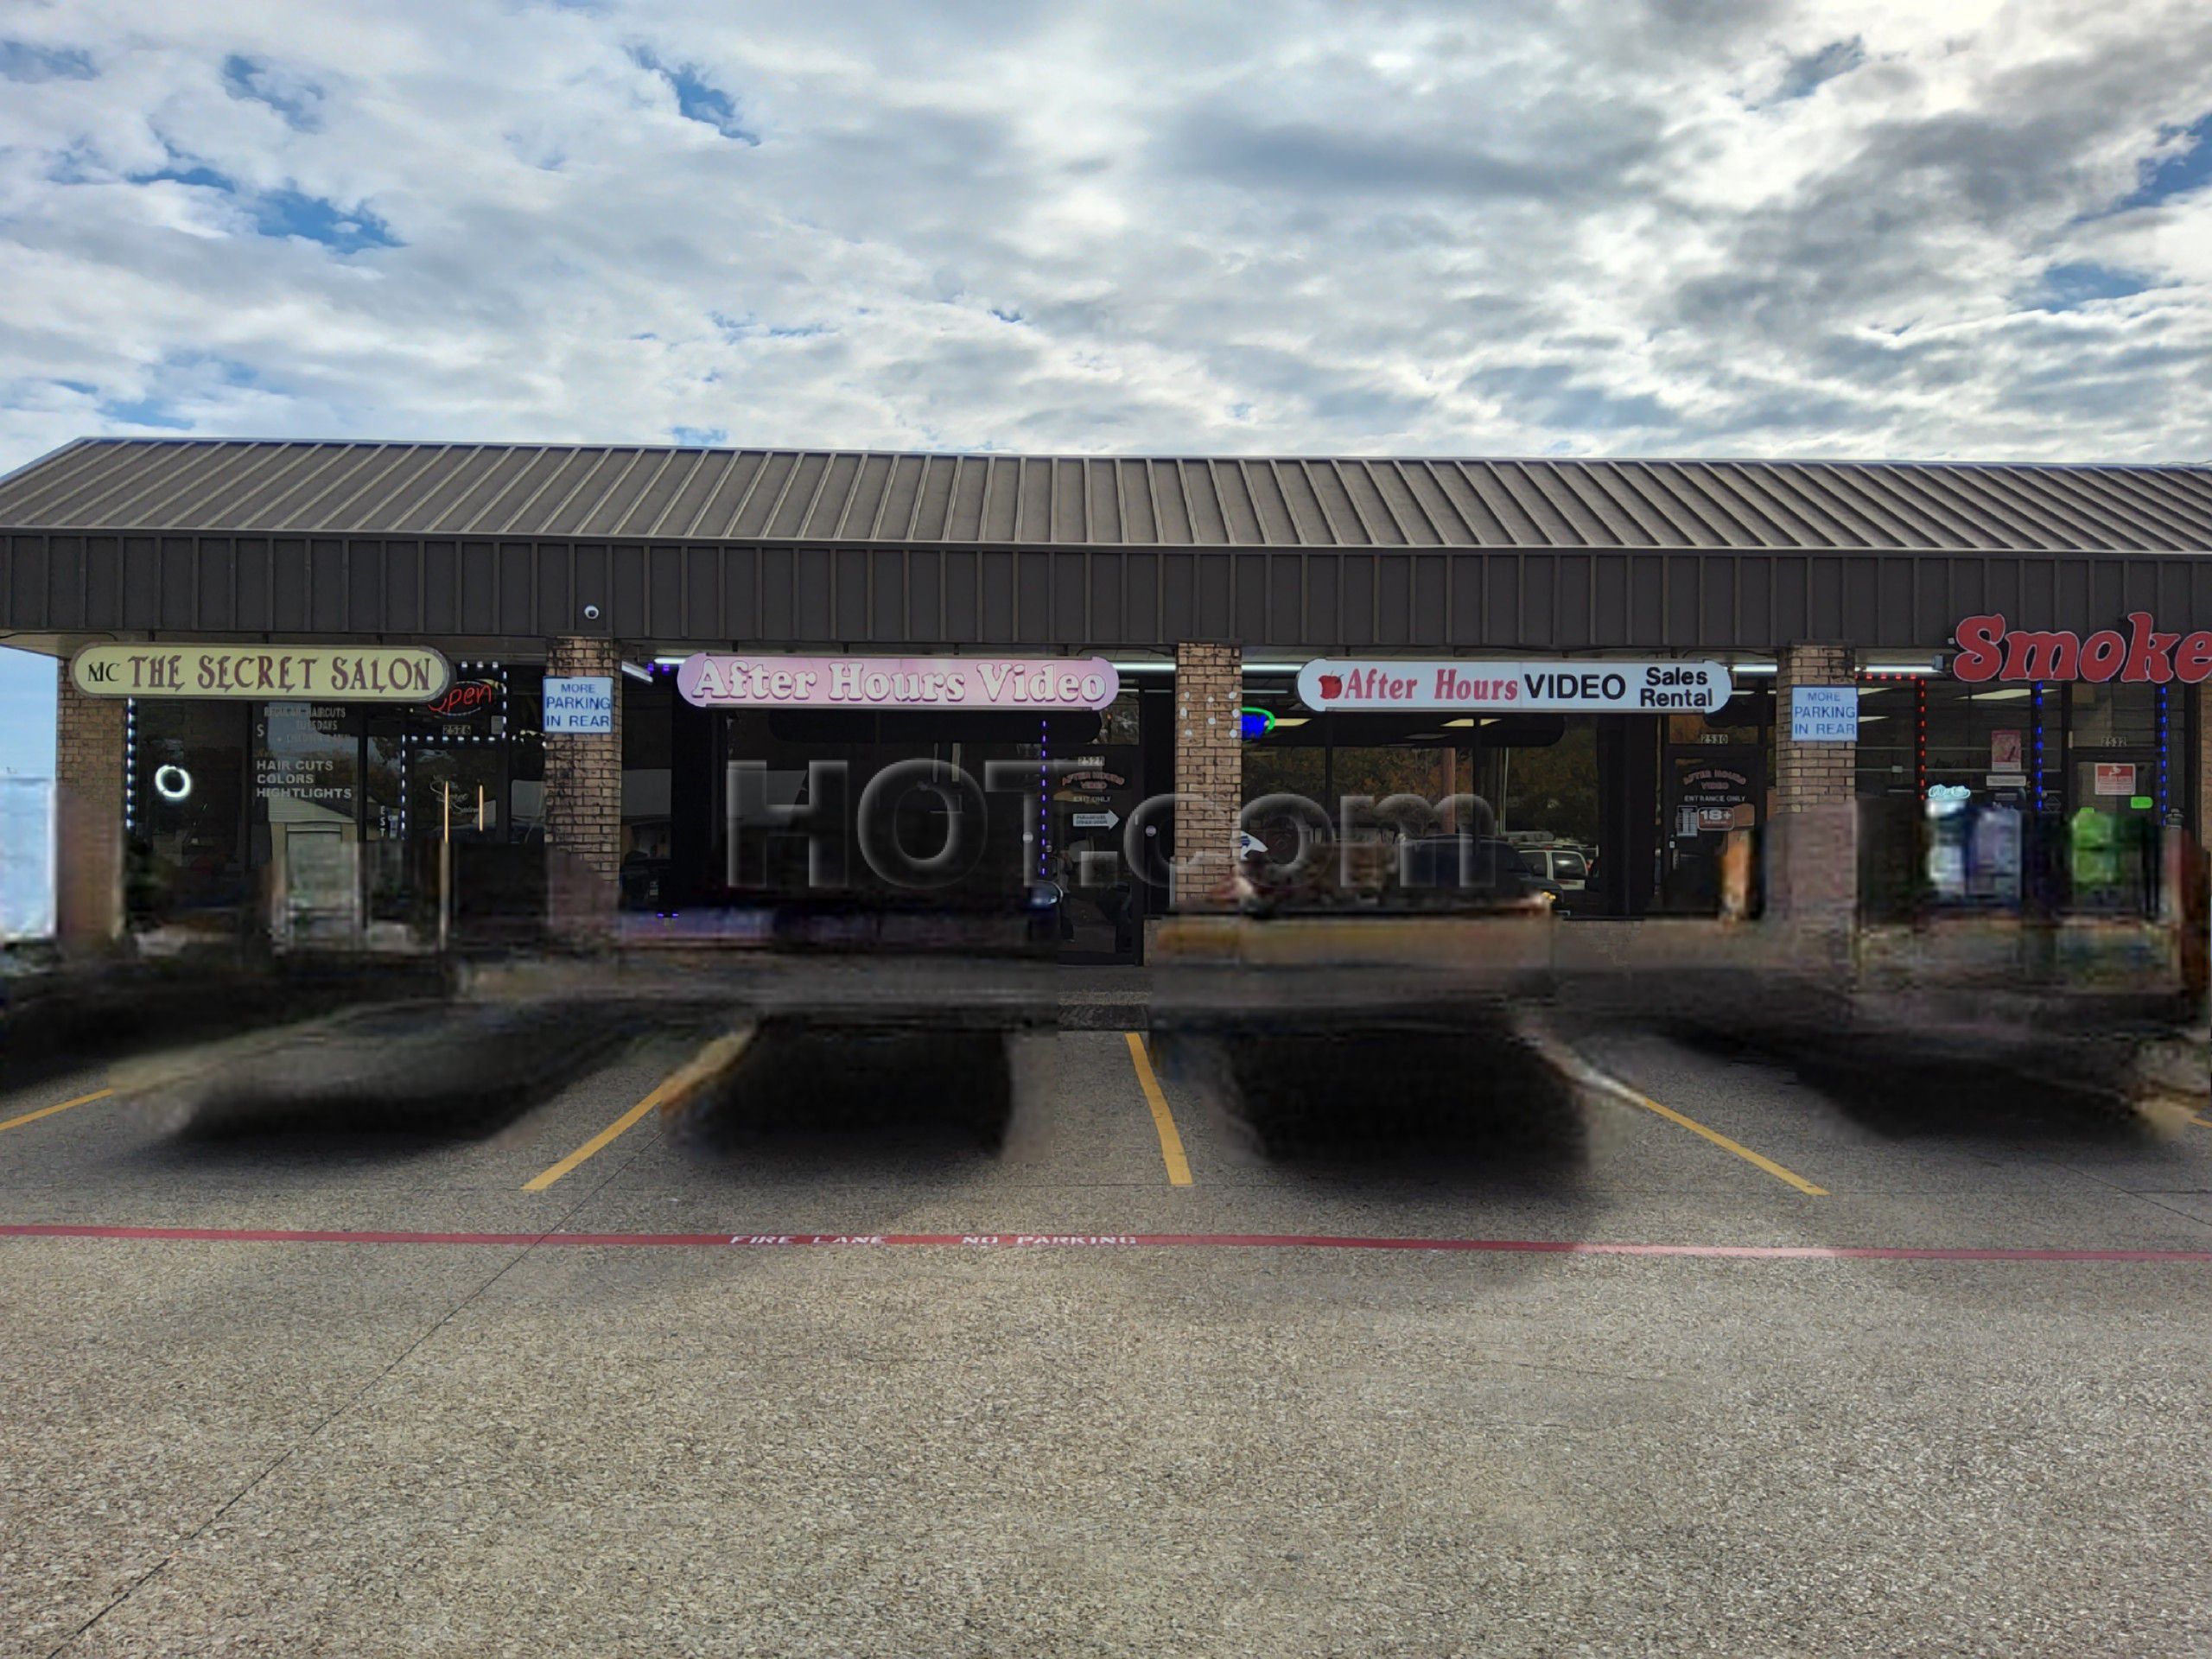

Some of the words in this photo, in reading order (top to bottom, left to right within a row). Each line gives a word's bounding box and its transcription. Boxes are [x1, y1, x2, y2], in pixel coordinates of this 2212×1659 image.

[1953, 612, 2212, 683] Smoke
[88, 662, 120, 682] MC
[128, 655, 185, 691] THE
[198, 655, 318, 692] SECRET
[331, 657, 430, 693] SALON
[1646, 667, 1707, 686] Sales
[691, 659, 817, 700] After
[829, 663, 966, 702] Hours
[976, 664, 1107, 702] Video
[1344, 668, 1418, 700] After
[1434, 669, 1518, 700] Hours
[1524, 674, 1626, 700] VIDEO
[561, 683, 595, 694] MORE
[1640, 689, 1712, 707] Rental
[1808, 692, 1840, 702] MORE
[546, 696, 611, 710] PARKING
[1795, 706, 1856, 718] PARKING
[546, 715, 561, 727] IN
[569, 715, 609, 727] REAR
[1795, 723, 1808, 734] IN
[1816, 723, 1855, 734] REAR
[257, 760, 290, 771] HAIR
[295, 760, 334, 771] CUTS
[257, 774, 315, 784] COLORS
[256, 788, 352, 798] HIGHTLIGHTS
[1700, 810, 1732, 820] 18+
[730, 1236, 796, 1244] FIRE
[812, 1236, 886, 1245] LANE
[1016, 1236, 1135, 1245] PARKING
